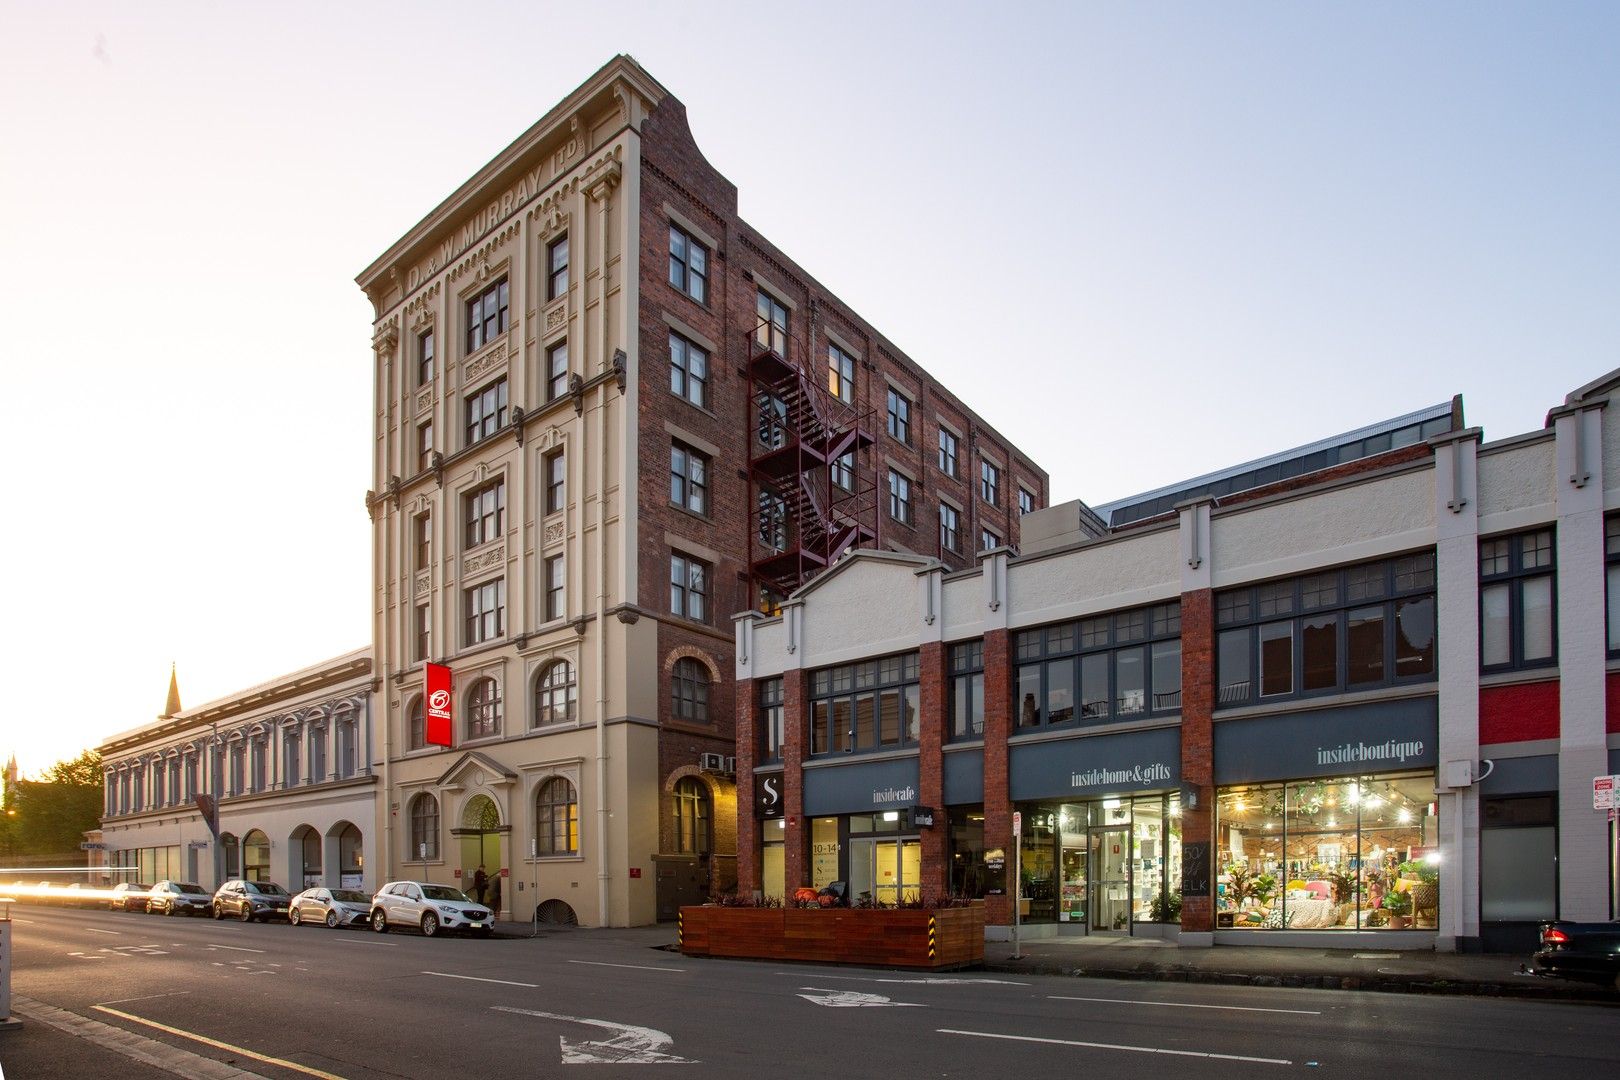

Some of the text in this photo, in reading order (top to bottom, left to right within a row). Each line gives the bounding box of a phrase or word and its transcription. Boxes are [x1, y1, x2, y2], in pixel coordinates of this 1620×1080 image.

[428, 257, 437, 274] &
[462, 164, 544, 248] MURRAY
[550, 139, 577, 181] LTD
[1317, 740, 1424, 765] insideboutique
[1071, 763, 1171, 787] insidehome&gifts
[762, 777, 778, 805] S
[873, 786, 914, 803] insidecafe
